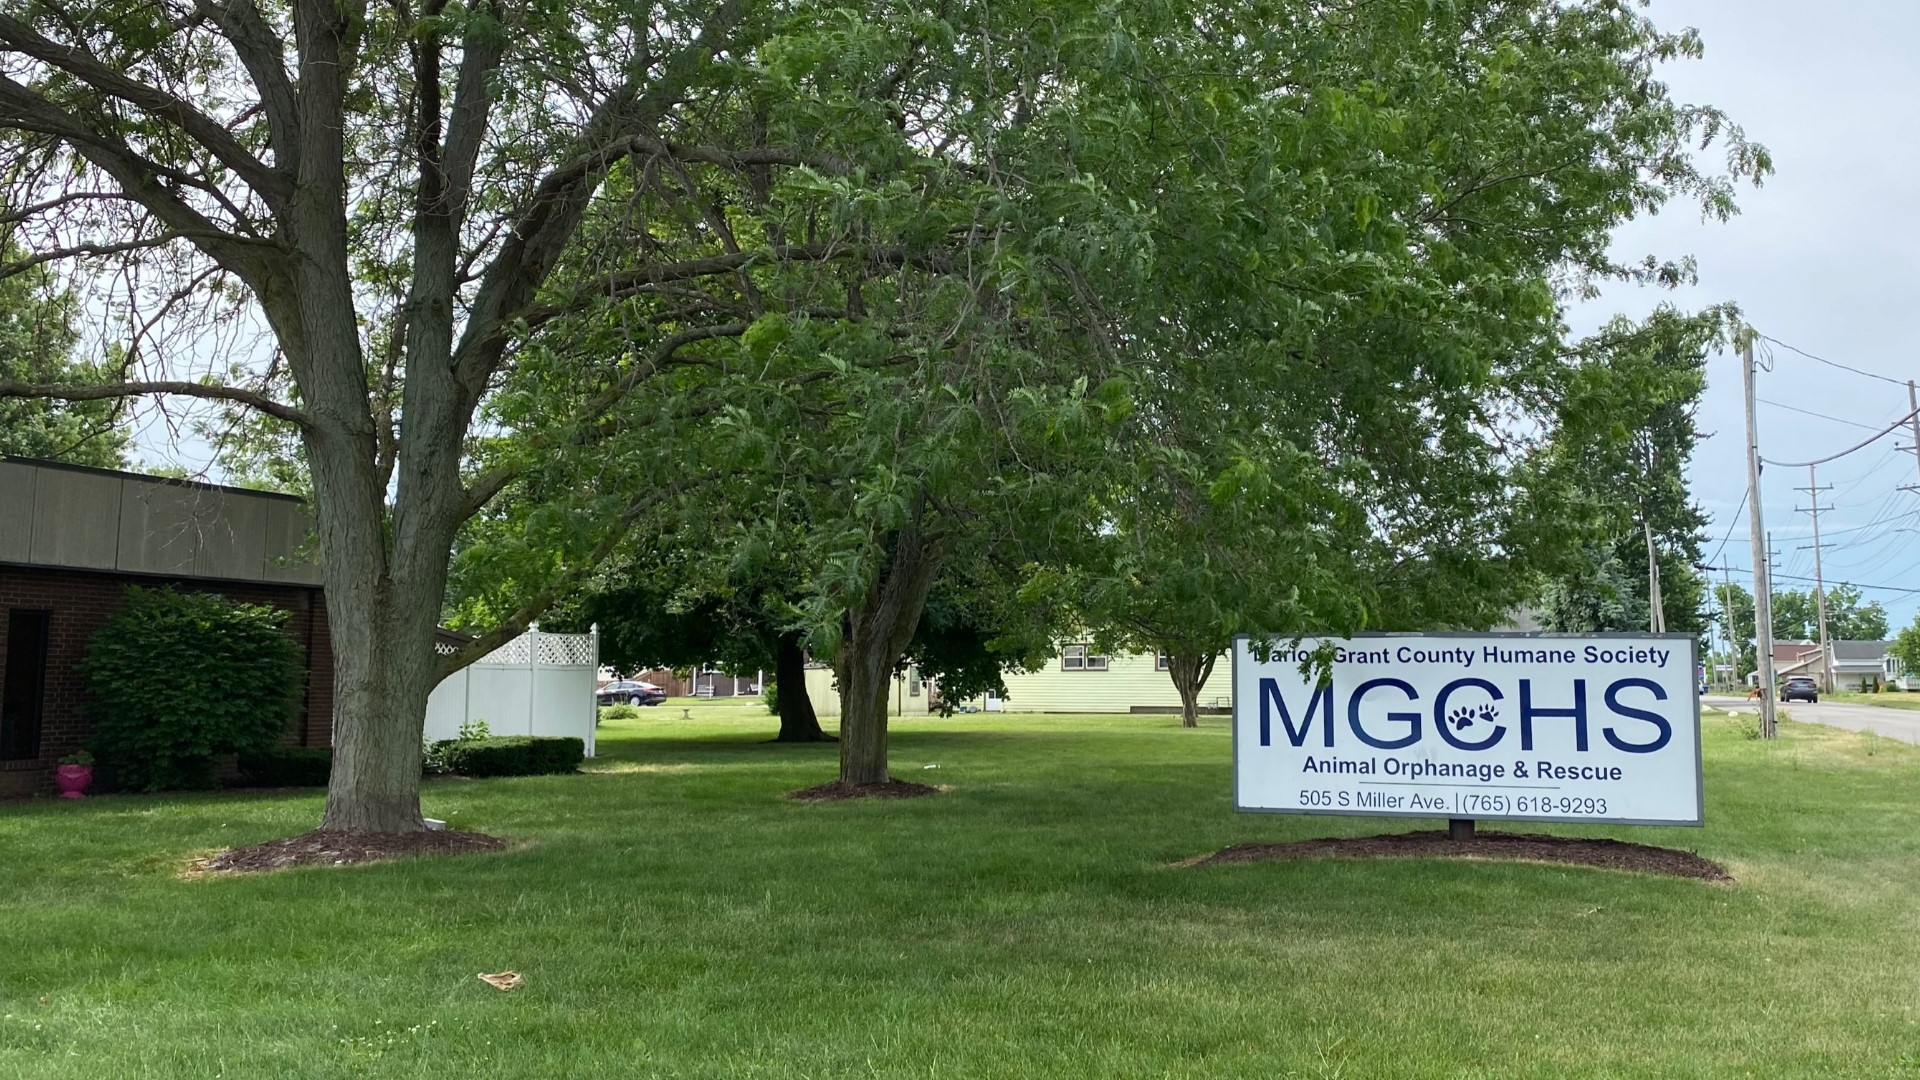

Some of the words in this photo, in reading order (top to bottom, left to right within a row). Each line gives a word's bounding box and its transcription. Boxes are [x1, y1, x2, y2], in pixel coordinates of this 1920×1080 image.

[1333, 646, 1391, 664] Grant
[1396, 646, 1476, 668] County
[1483, 645, 1576, 664] Humane
[1583, 645, 1671, 668] Society
[1259, 677, 1672, 754] MGCHS
[1302, 755, 1376, 776] Animal
[1383, 757, 1506, 782] Orphanage
[1513, 760, 1529, 779] &
[1537, 761, 1622, 781] Rescue
[1299, 790, 1332, 807] 505
[1338, 790, 1350, 807] S
[1357, 791, 1405, 810] Miller
[1410, 793, 1450, 811] Ave.
[1517, 795, 1608, 816] 618-9293
